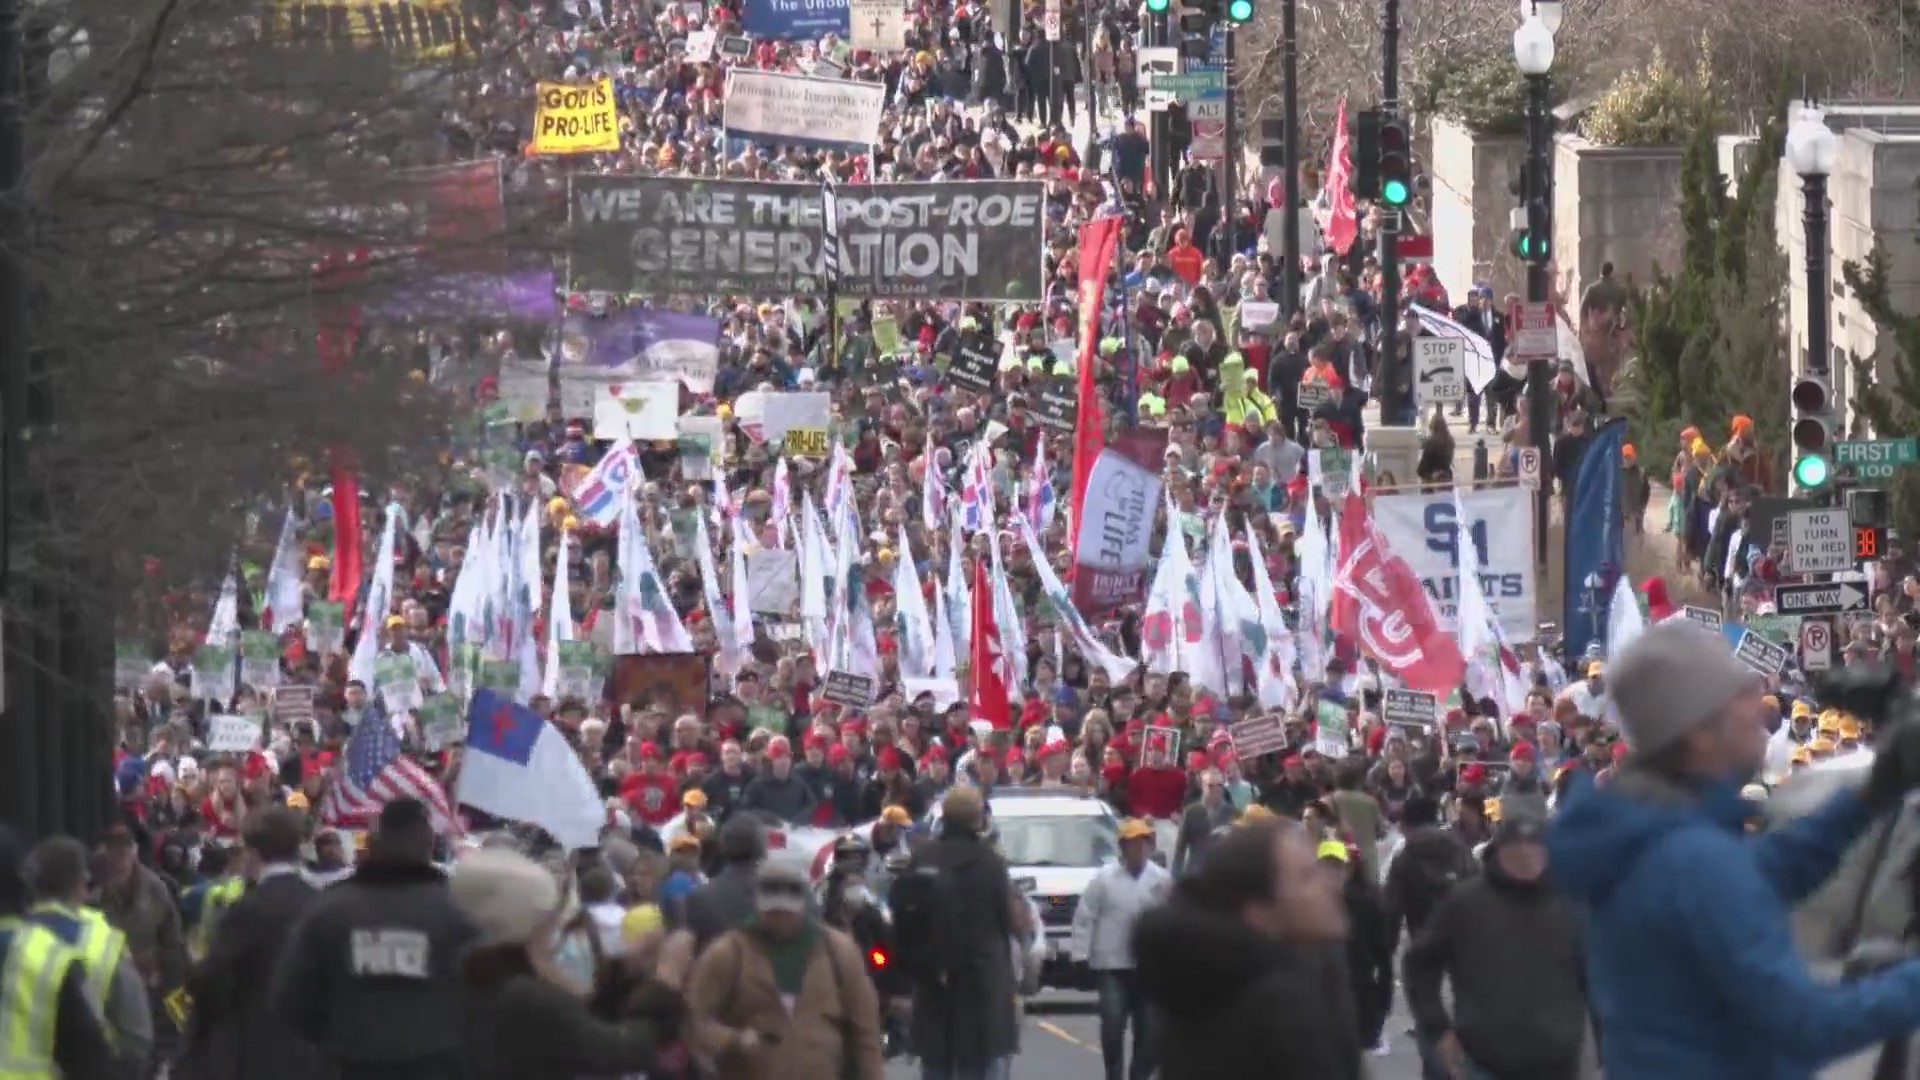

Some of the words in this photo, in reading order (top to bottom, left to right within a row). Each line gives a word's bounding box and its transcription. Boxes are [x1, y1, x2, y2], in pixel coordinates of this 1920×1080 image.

[771, 0, 798, 12] The
[545, 88, 588, 110] GOD
[592, 84, 607, 106] IS
[1197, 104, 1220, 116] ALT
[542, 111, 612, 137] PRO-LIFE
[577, 189, 641, 223] WE
[653, 189, 735, 225] ARE
[746, 193, 822, 227] THE
[836, 193, 1040, 228] POST-ROE
[631, 226, 980, 278] GENERATION
[1423, 342, 1457, 355] STOP
[966, 360, 982, 374] My
[786, 429, 828, 452] PRO-LIFE
[1838, 442, 1894, 462] FIRST
[1858, 464, 1894, 478] 100
[1809, 514, 1830, 526] NO
[1100, 510, 1127, 569] LIFE
[1804, 528, 1838, 541] TURN
[1796, 543, 1814, 554] ON
[1821, 541, 1847, 553] RED
[1422, 573, 1523, 601] AITS
[1785, 592, 1812, 608] ONE
[1815, 590, 1841, 606] WAY
